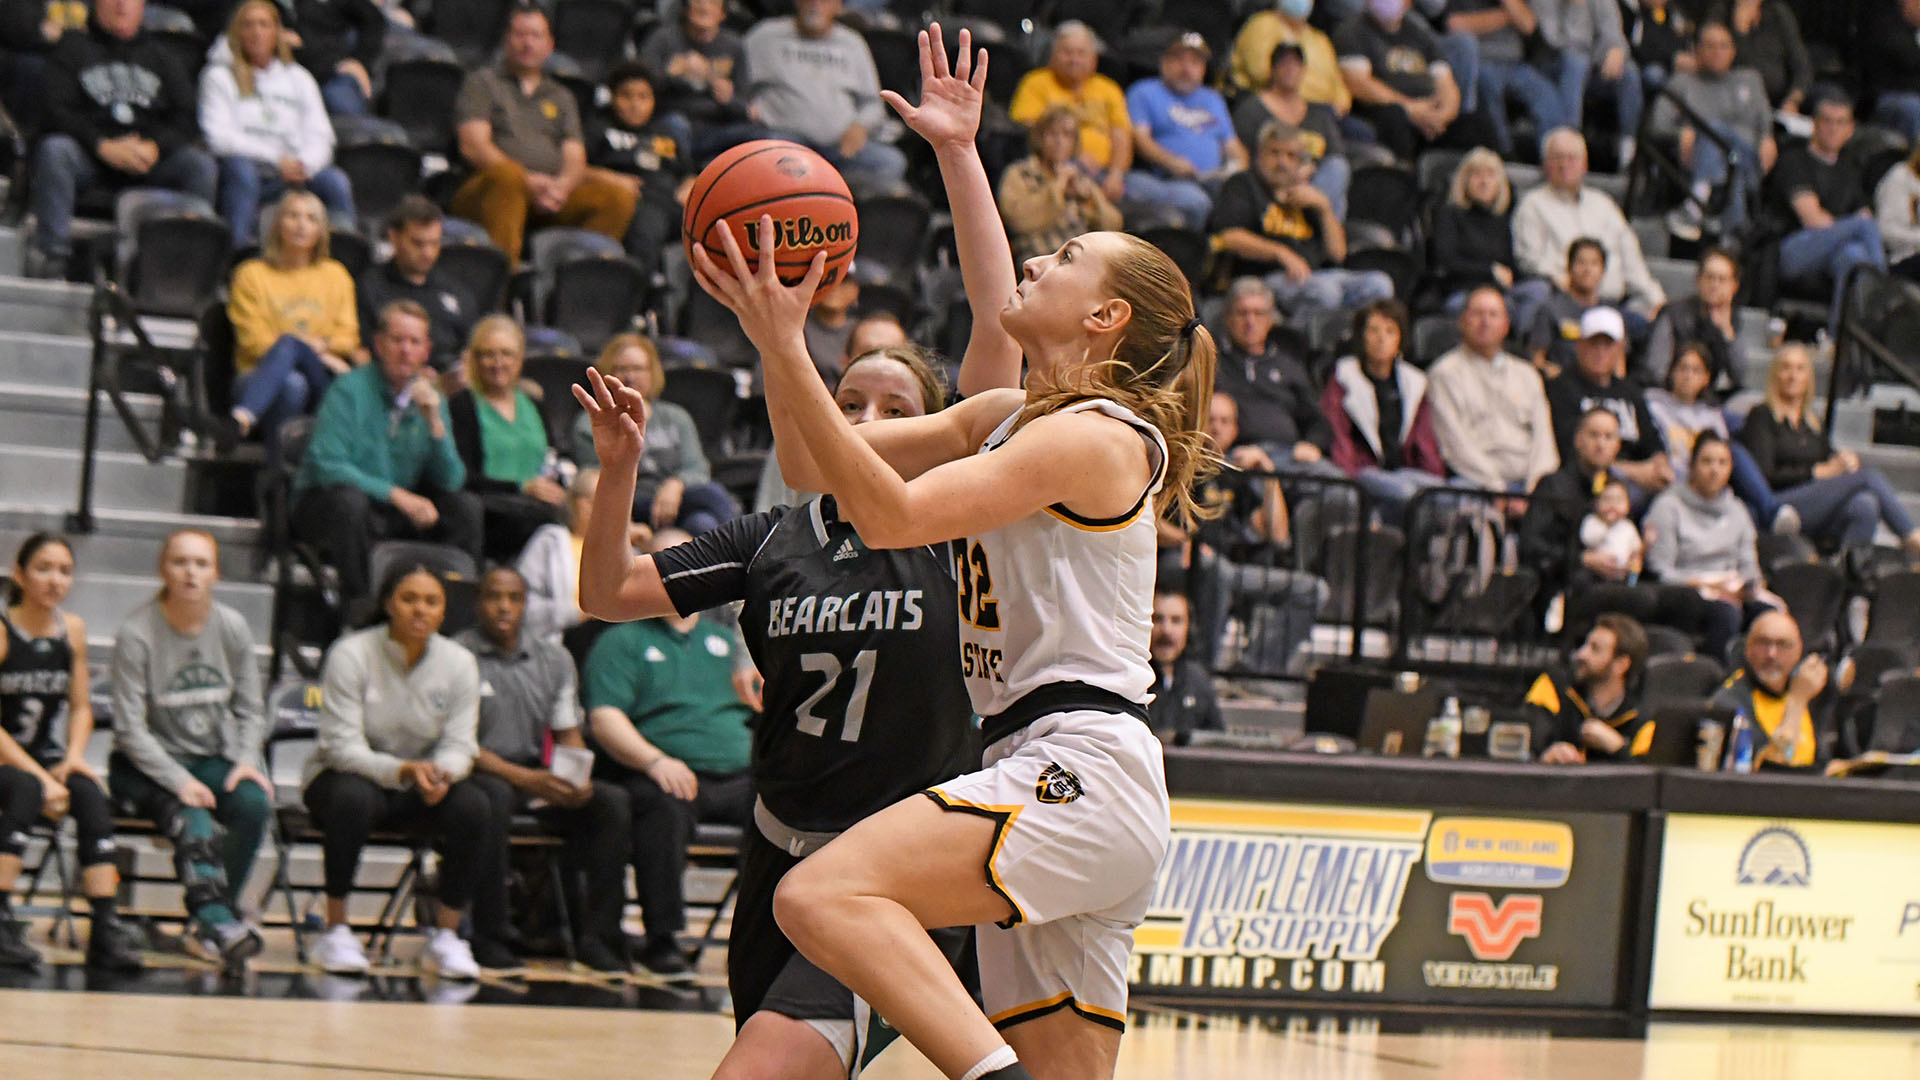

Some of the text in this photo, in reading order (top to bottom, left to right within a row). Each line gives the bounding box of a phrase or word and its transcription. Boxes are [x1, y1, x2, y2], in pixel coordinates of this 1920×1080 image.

[744, 216, 853, 251] Wilson
[833, 550, 859, 562] adidas
[768, 590, 923, 638] BEARCATS
[795, 650, 878, 742] 21
[1243, 916, 1388, 953] SUPPLY
[1684, 898, 1854, 943] Sunflower
[1725, 944, 1808, 984] Bank
